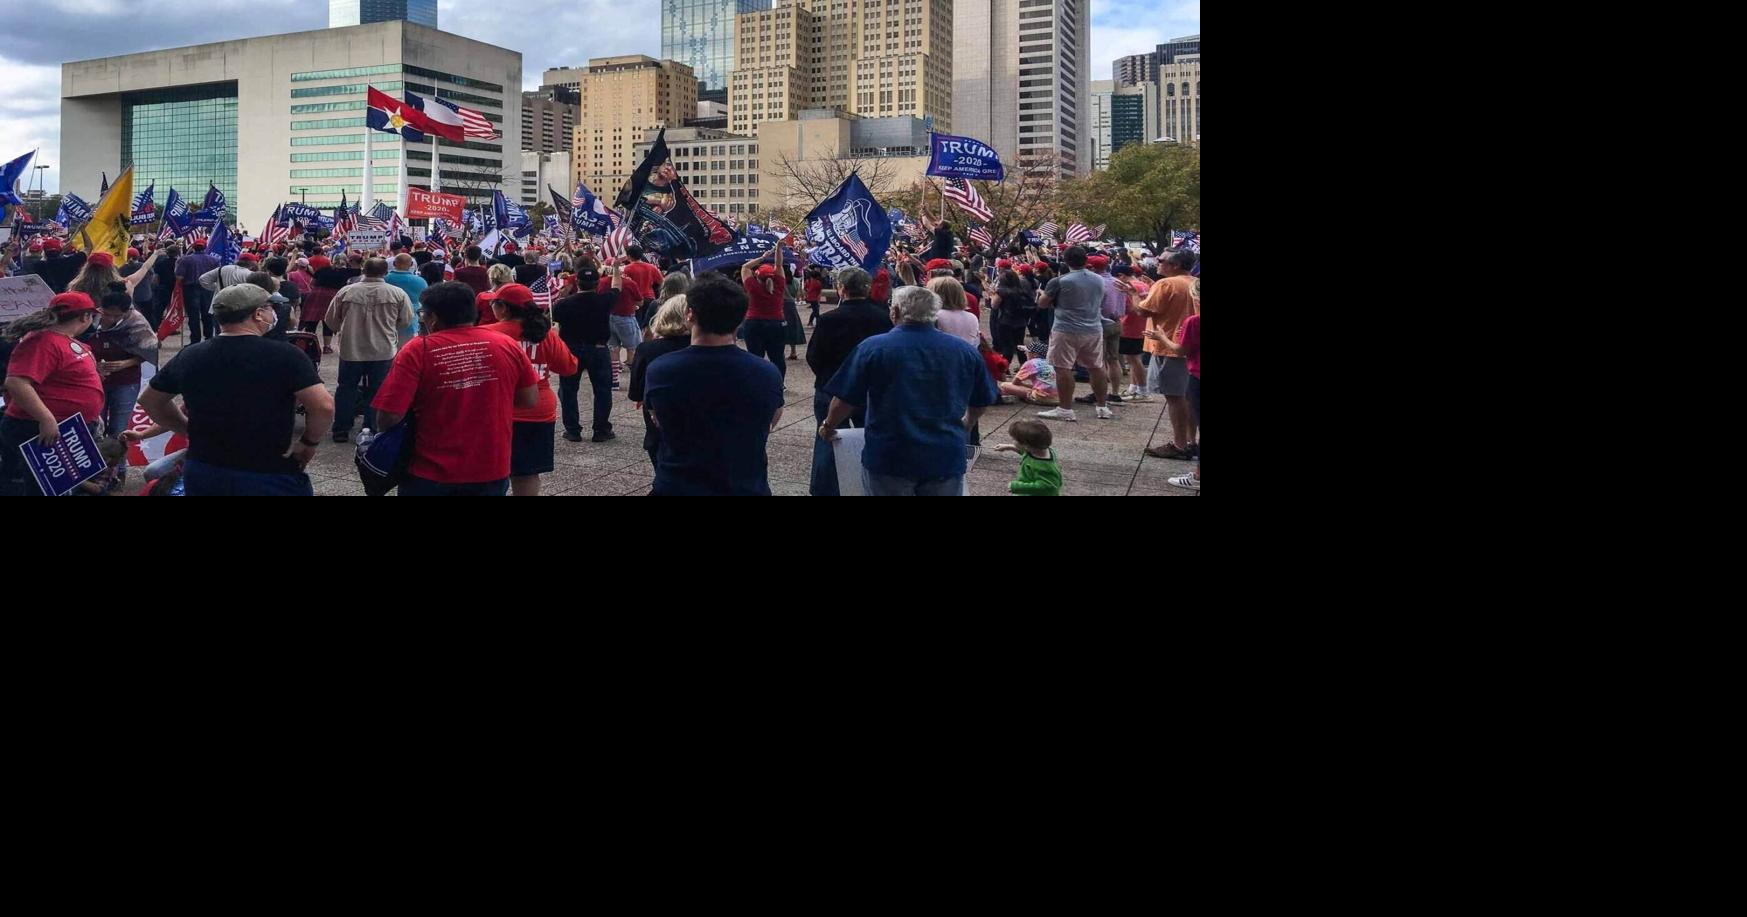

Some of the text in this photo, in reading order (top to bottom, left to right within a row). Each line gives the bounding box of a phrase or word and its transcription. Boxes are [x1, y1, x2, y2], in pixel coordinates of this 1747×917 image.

[940, 141, 999, 159] TRUM
[412, 191, 459, 207] TRUMP
[62, 426, 92, 470] TRUMP
[42, 447, 66, 479] 2020
